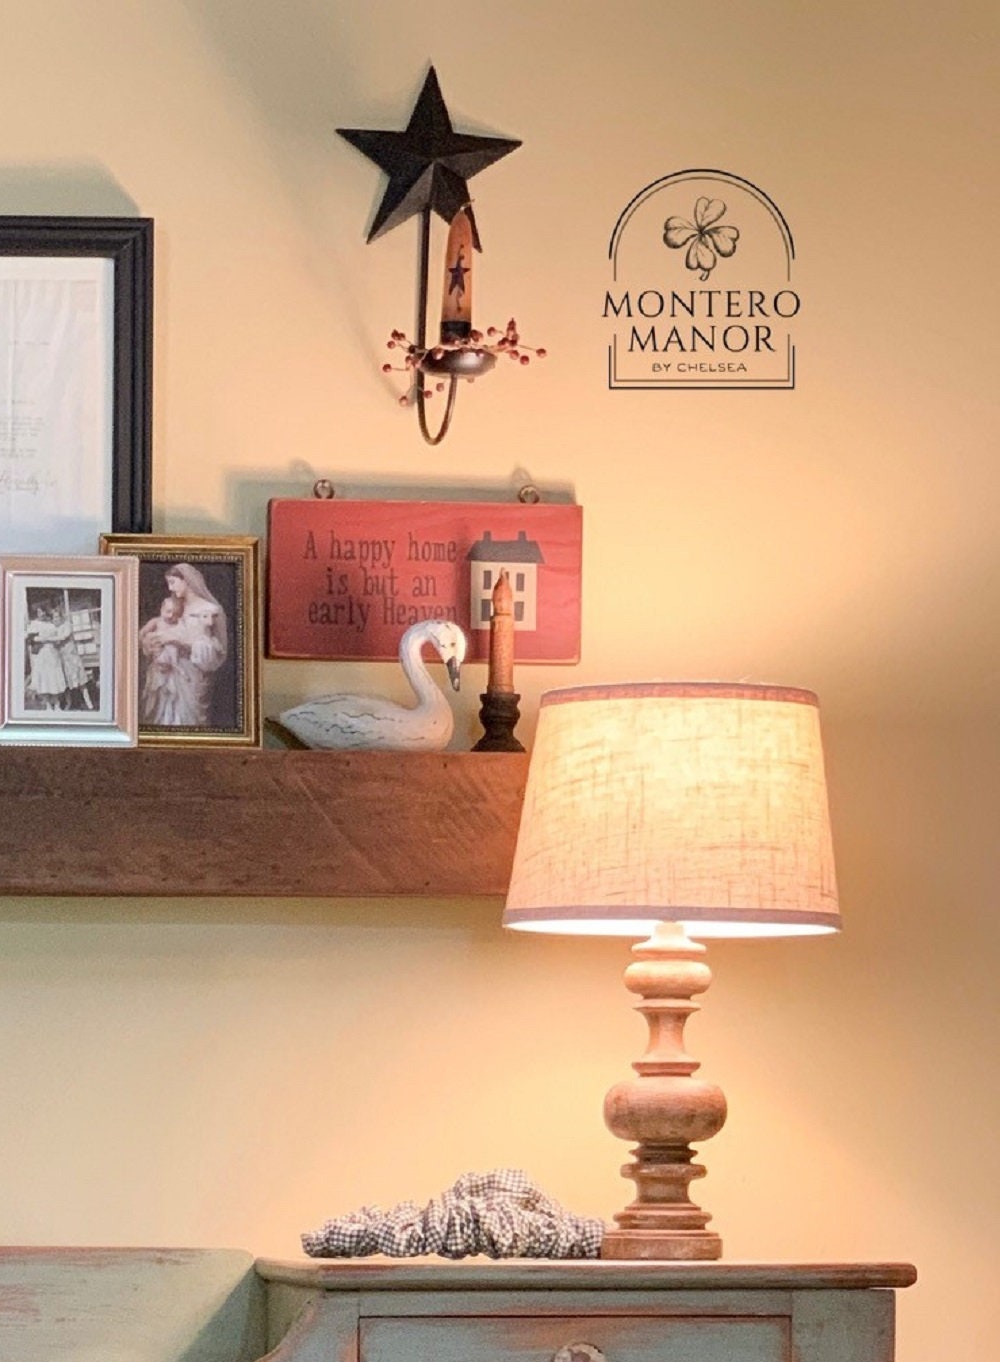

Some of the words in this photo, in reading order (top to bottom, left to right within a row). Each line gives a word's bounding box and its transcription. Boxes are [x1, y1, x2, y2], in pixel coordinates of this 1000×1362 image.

[303, 530, 318, 560] A
[330, 529, 396, 569] happy
[408, 532, 457, 563] home
[326, 567, 348, 594] is
[362, 566, 400, 595] but
[412, 576, 437, 596] an
[308, 595, 372, 632] early
[384, 597, 457, 626] Heaven
